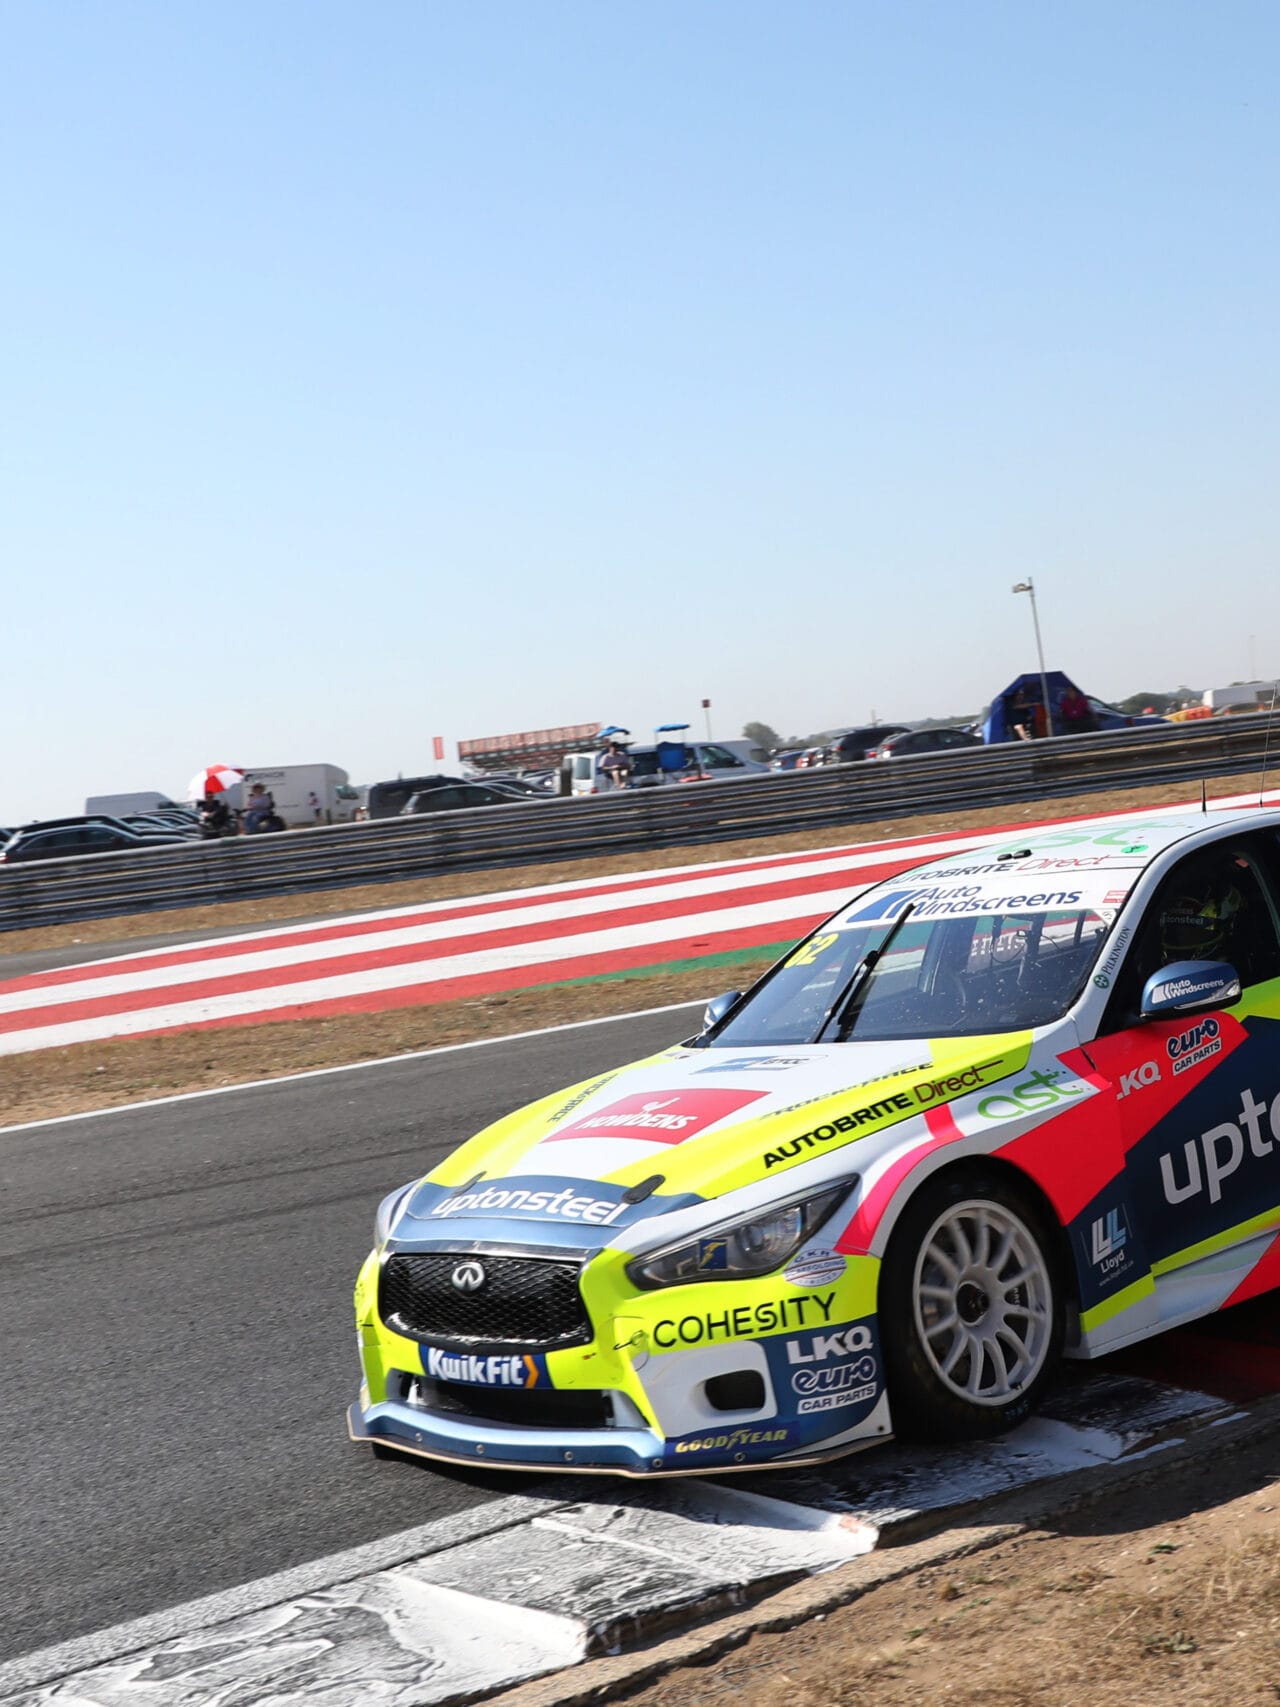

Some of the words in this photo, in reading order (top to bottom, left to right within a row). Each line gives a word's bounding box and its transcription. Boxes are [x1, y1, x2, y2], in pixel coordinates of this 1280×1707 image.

[915, 885, 982, 901] Auto
[1101, 927, 1131, 975] PILKINGTON
[1169, 979, 1191, 989] Auto
[1171, 979, 1225, 997] Windscreens
[1167, 1018, 1220, 1059] euro
[1174, 1056, 1193, 1073] CAR
[1194, 1040, 1221, 1064] PARTS
[1116, 1061, 1162, 1101] KQ
[763, 1093, 914, 1169] AUTOBRITE
[912, 1059, 1004, 1104] Direct
[432, 1187, 630, 1225] uptonsteel
[1100, 1249, 1125, 1274] Lloyd
[653, 1292, 836, 1348] COHESITY
[786, 1325, 874, 1365] LKQ
[428, 1347, 524, 1385] KwikFit
[791, 1355, 877, 1395] euro
[801, 1398, 832, 1412] CAR
[835, 1386, 875, 1406] PARTS
[675, 1429, 788, 1453] GOODYEAR
